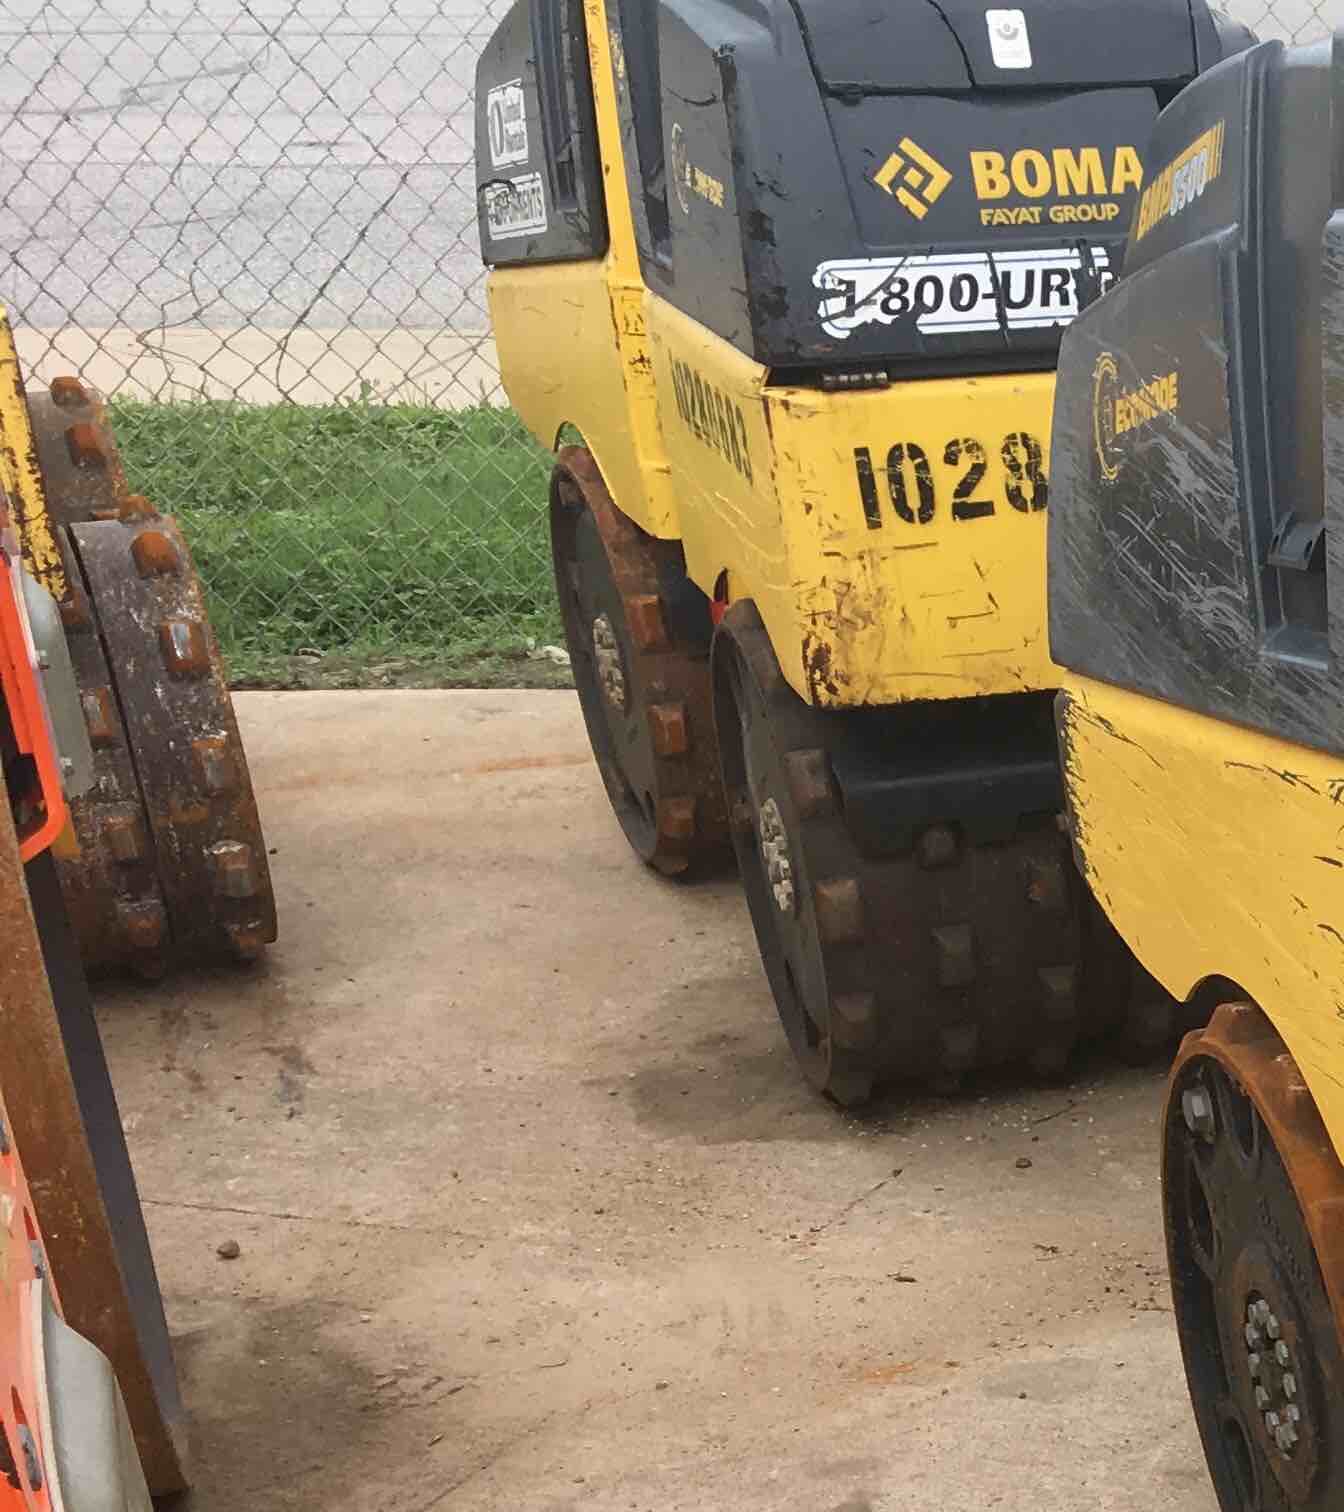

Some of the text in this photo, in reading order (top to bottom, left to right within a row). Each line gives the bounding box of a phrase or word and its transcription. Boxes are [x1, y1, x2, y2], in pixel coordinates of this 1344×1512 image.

[980, 203, 1120, 226] FAYAT GROUP
[836, 267, 1072, 318] 1-800-UR
[853, 431, 1049, 529] 1028
